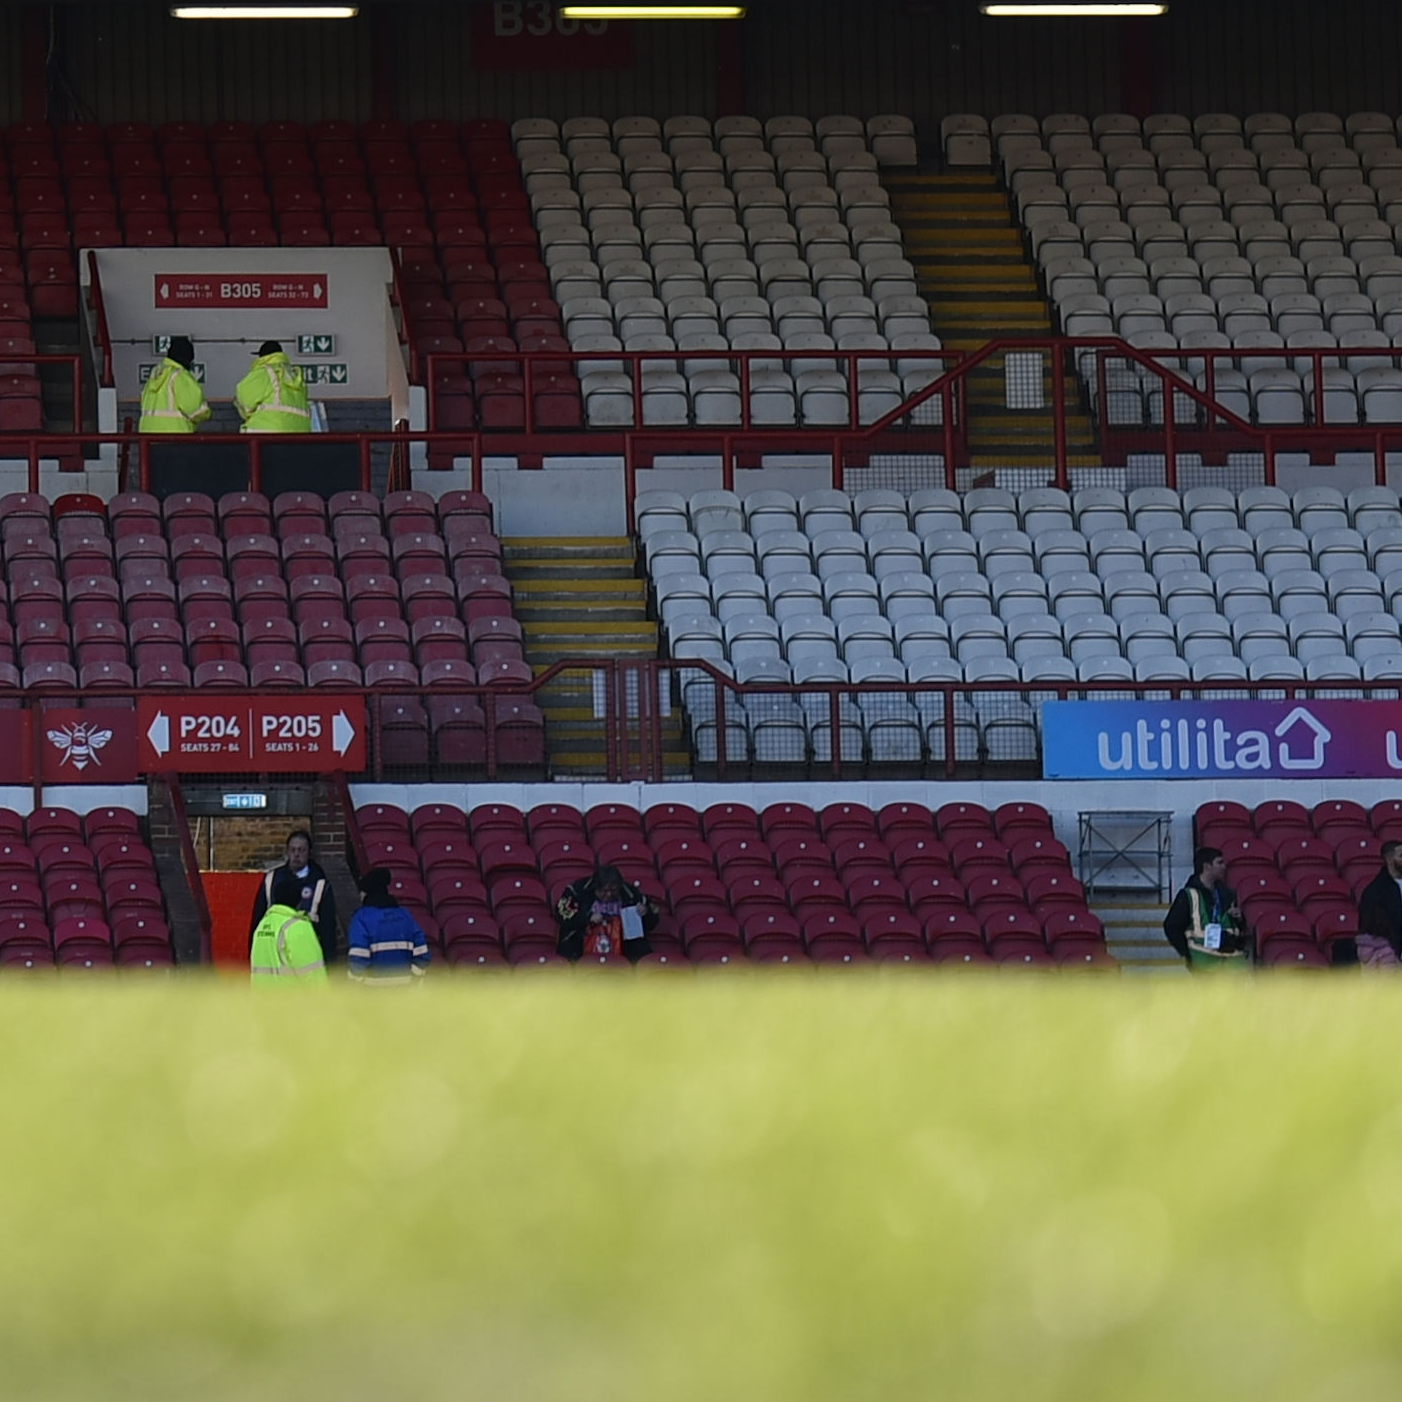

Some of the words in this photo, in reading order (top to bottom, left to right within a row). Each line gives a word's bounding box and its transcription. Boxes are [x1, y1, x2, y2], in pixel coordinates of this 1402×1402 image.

[220, 283, 261, 299] B305
[180, 715, 240, 738] P204
[261, 714, 321, 738] P205
[180, 742, 209, 752] SEATS
[210, 742, 221, 752] 27
[265, 742, 294, 752] SEATS
[295, 742, 300, 752] 1
[307, 742, 319, 752] 26
[1098, 718, 1272, 771] utilita
